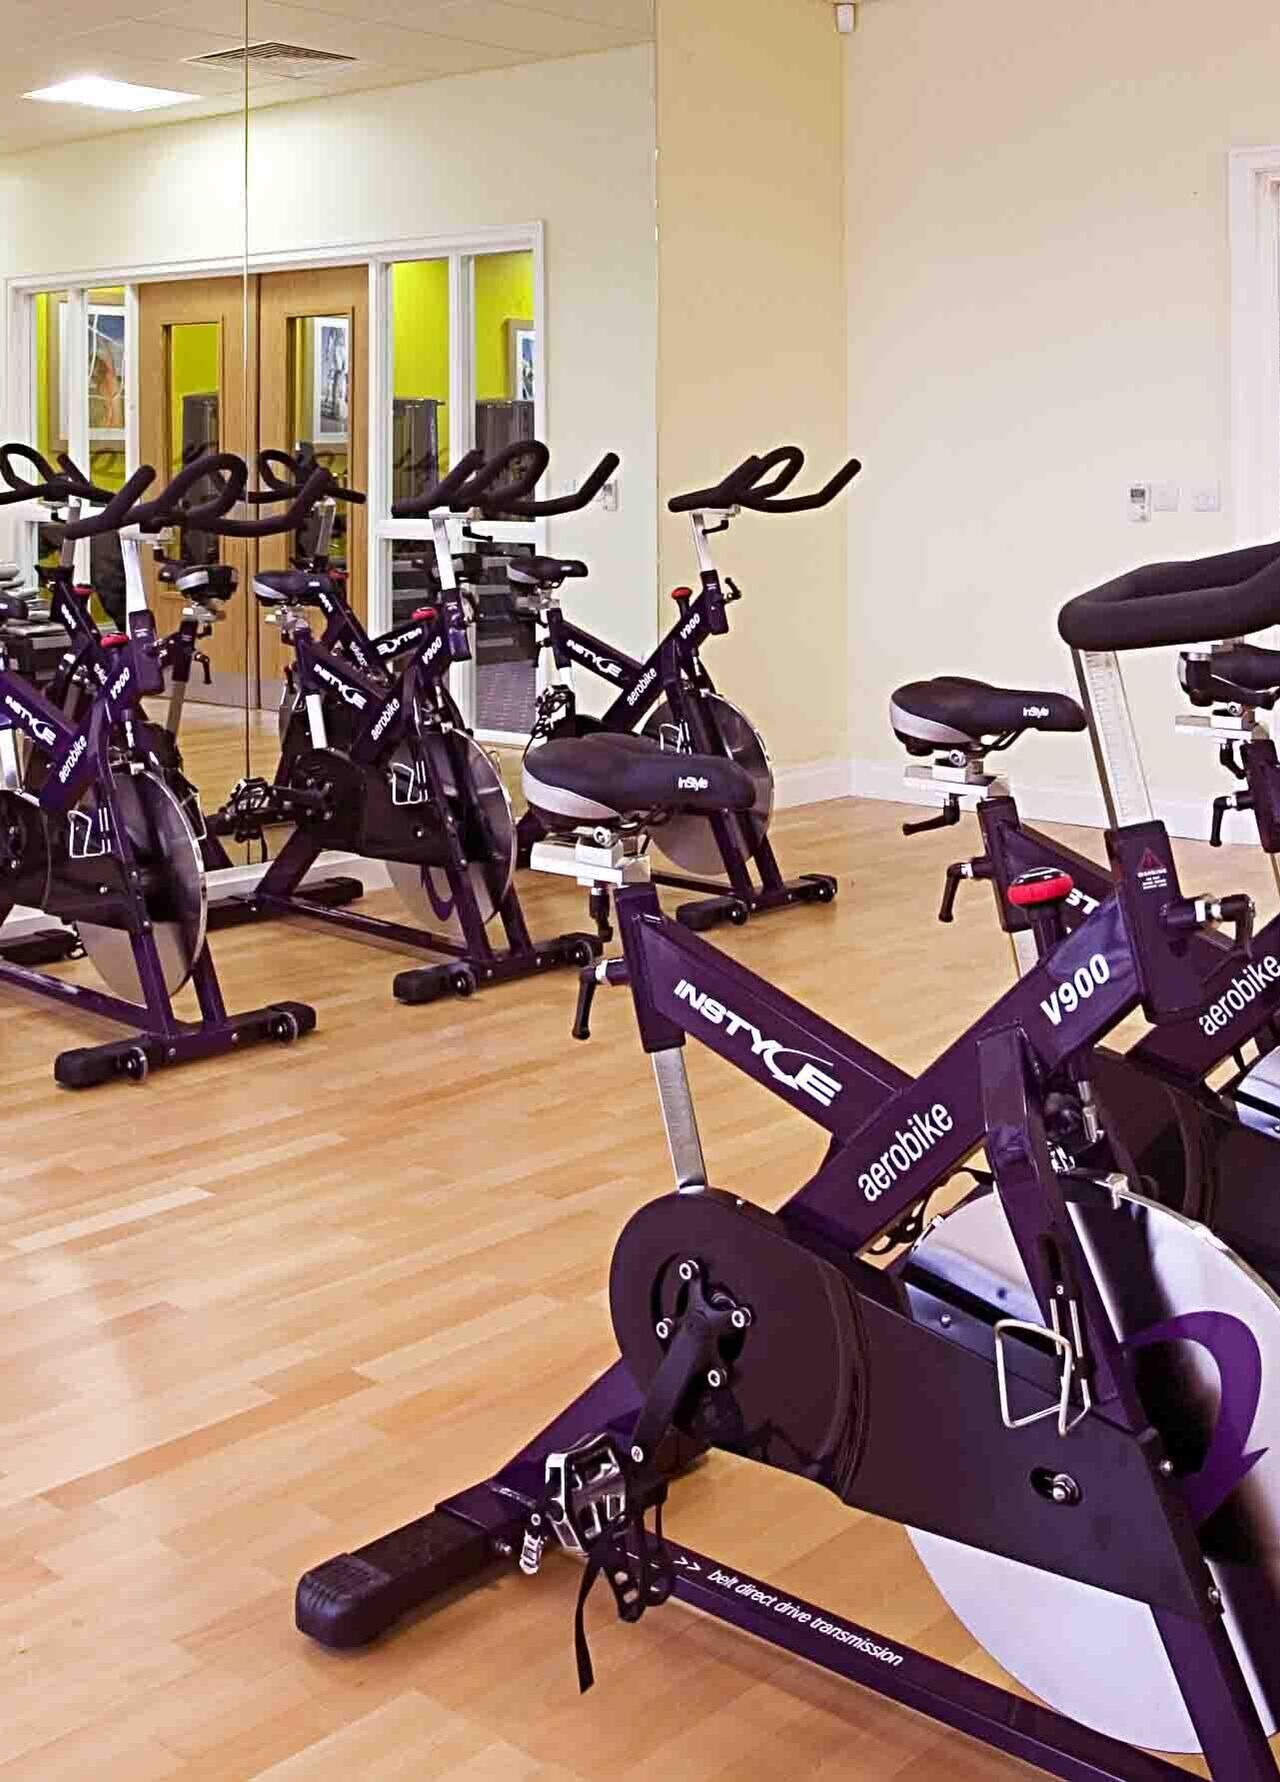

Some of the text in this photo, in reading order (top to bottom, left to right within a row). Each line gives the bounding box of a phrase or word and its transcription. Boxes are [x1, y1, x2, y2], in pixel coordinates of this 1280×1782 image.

[370, 698, 401, 741] aerobike
[626, 667, 658, 706] aerobike
[1039, 953, 1111, 1027] V900
[673, 978, 843, 1107] INSTYLE
[858, 1103, 954, 1202] aerobike
[707, 1569, 904, 1668] belt direct drive transmission
